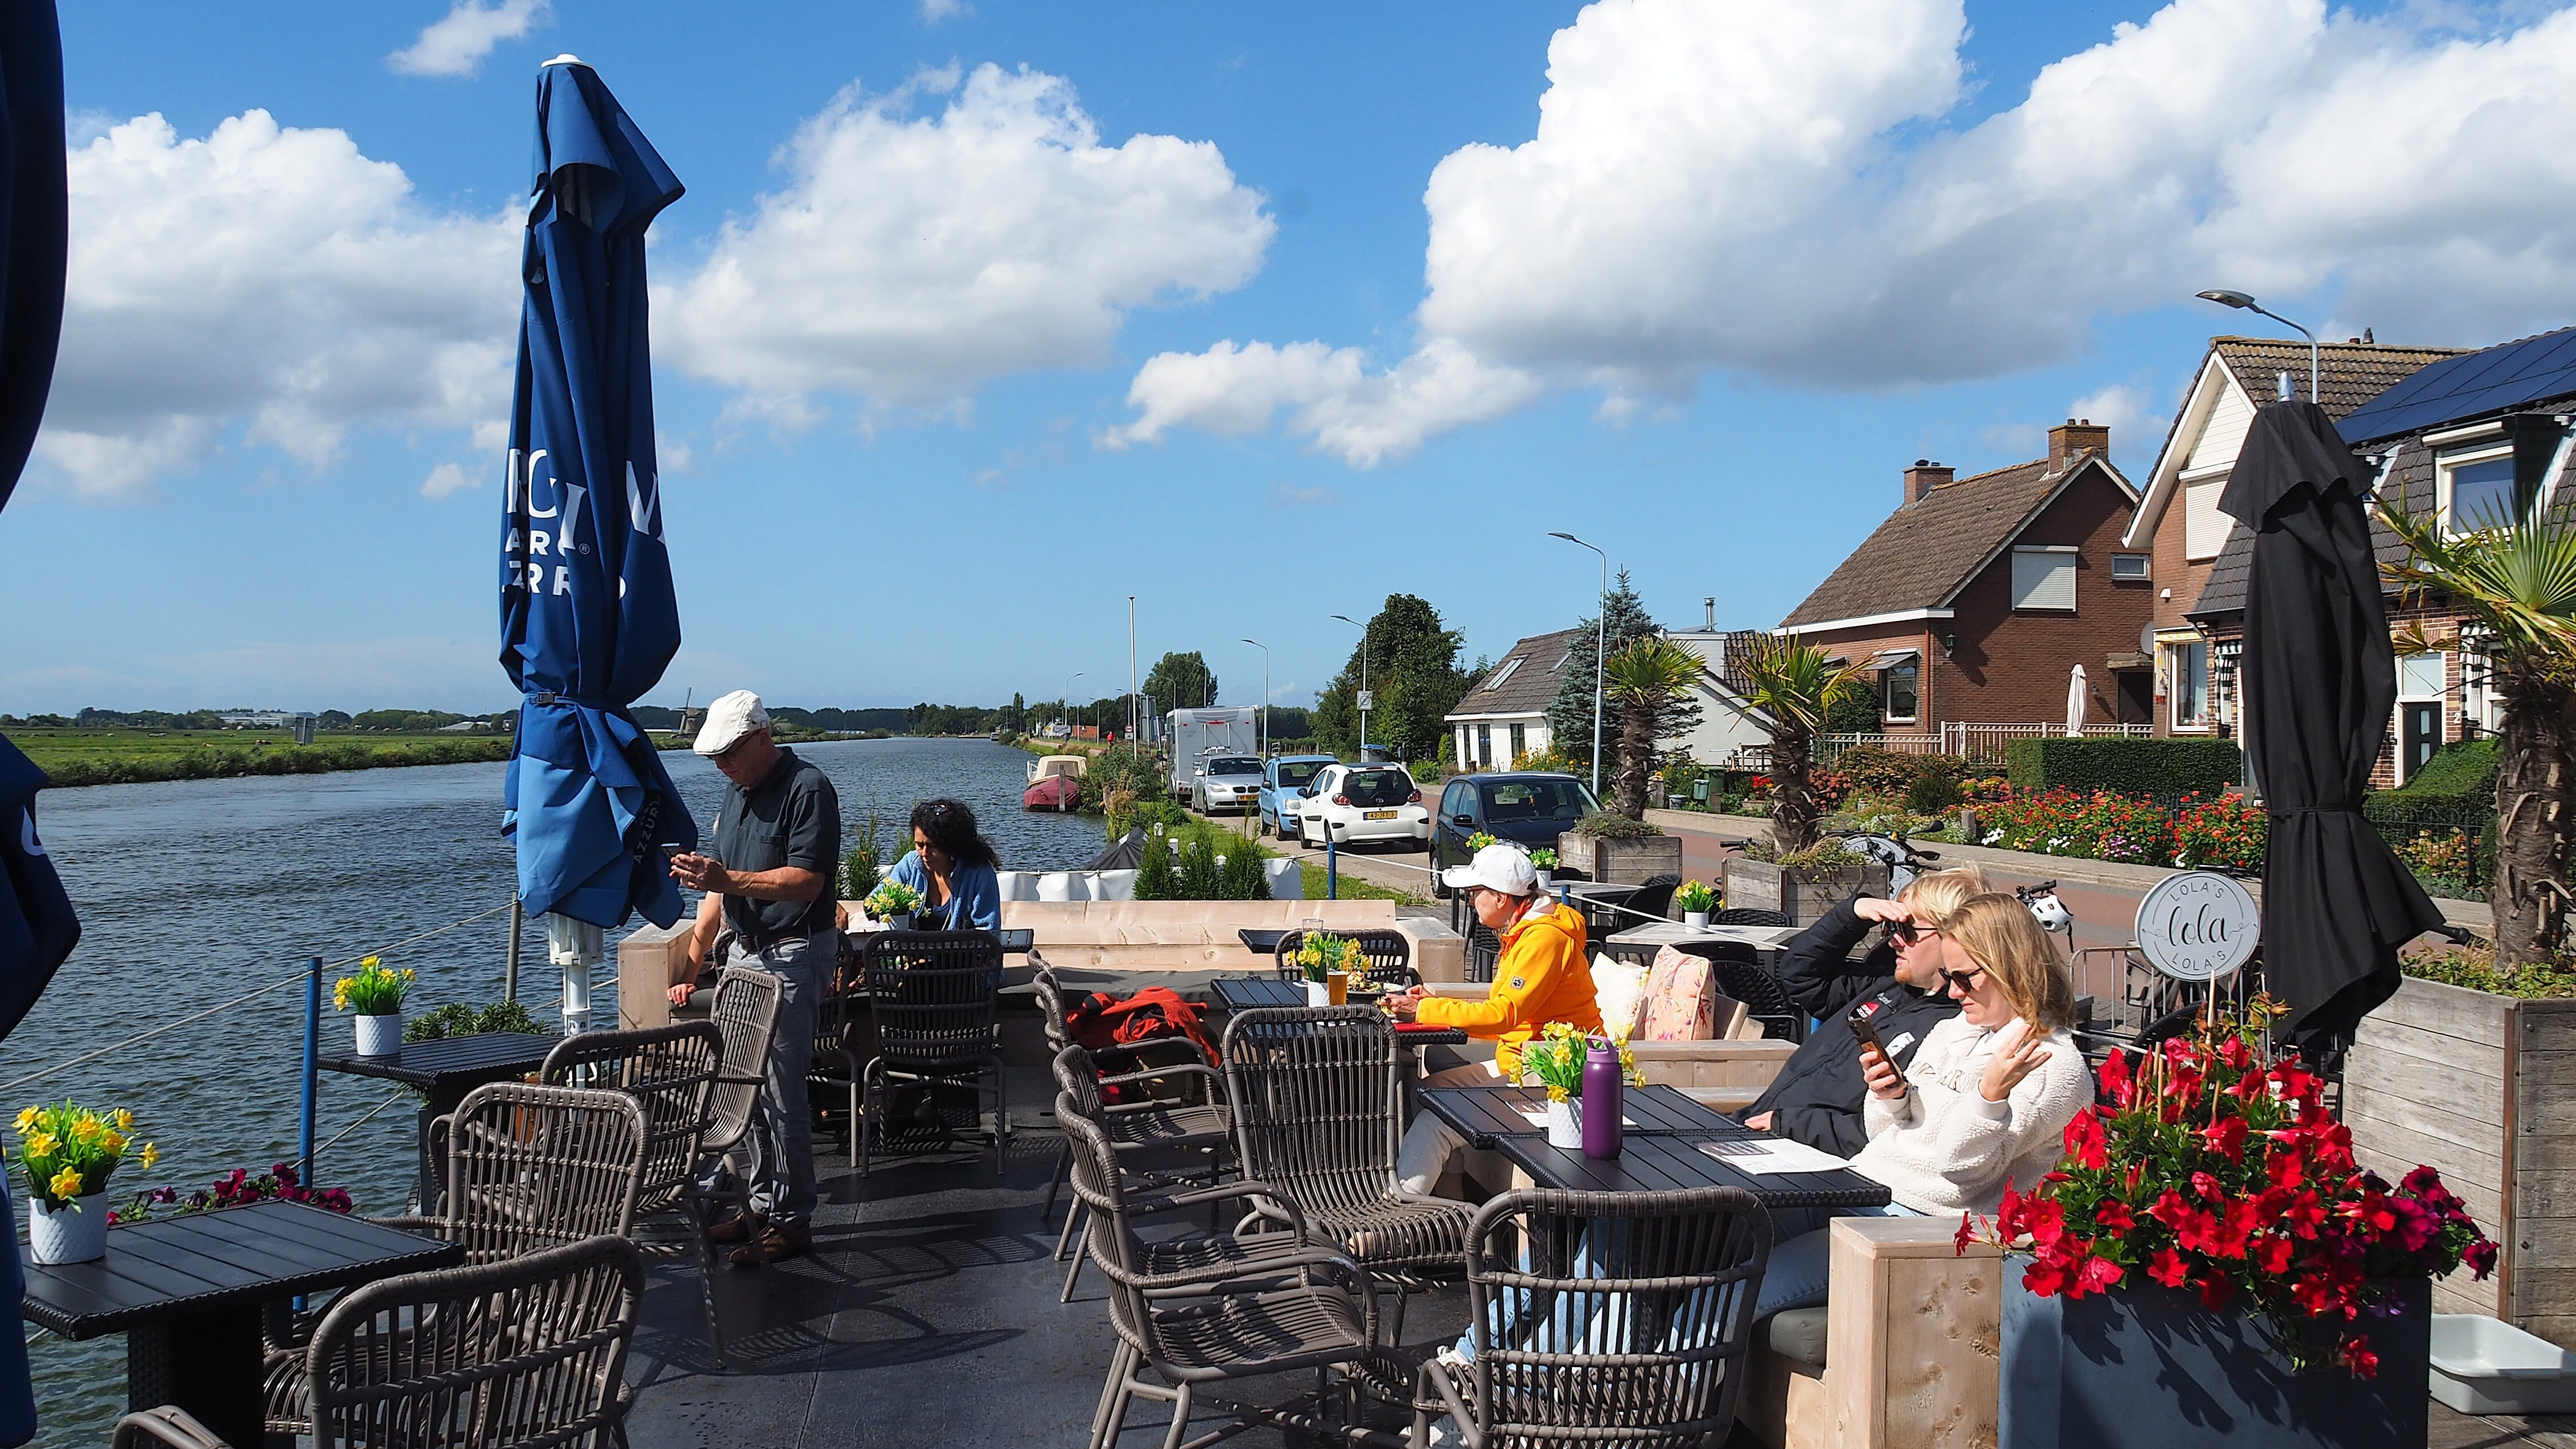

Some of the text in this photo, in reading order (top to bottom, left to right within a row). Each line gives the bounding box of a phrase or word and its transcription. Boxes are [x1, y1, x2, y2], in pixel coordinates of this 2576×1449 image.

[2170, 882, 2224, 902] LOLA'S
[2166, 903, 2229, 947] lola
[2172, 950, 2225, 971] LOLA'S
